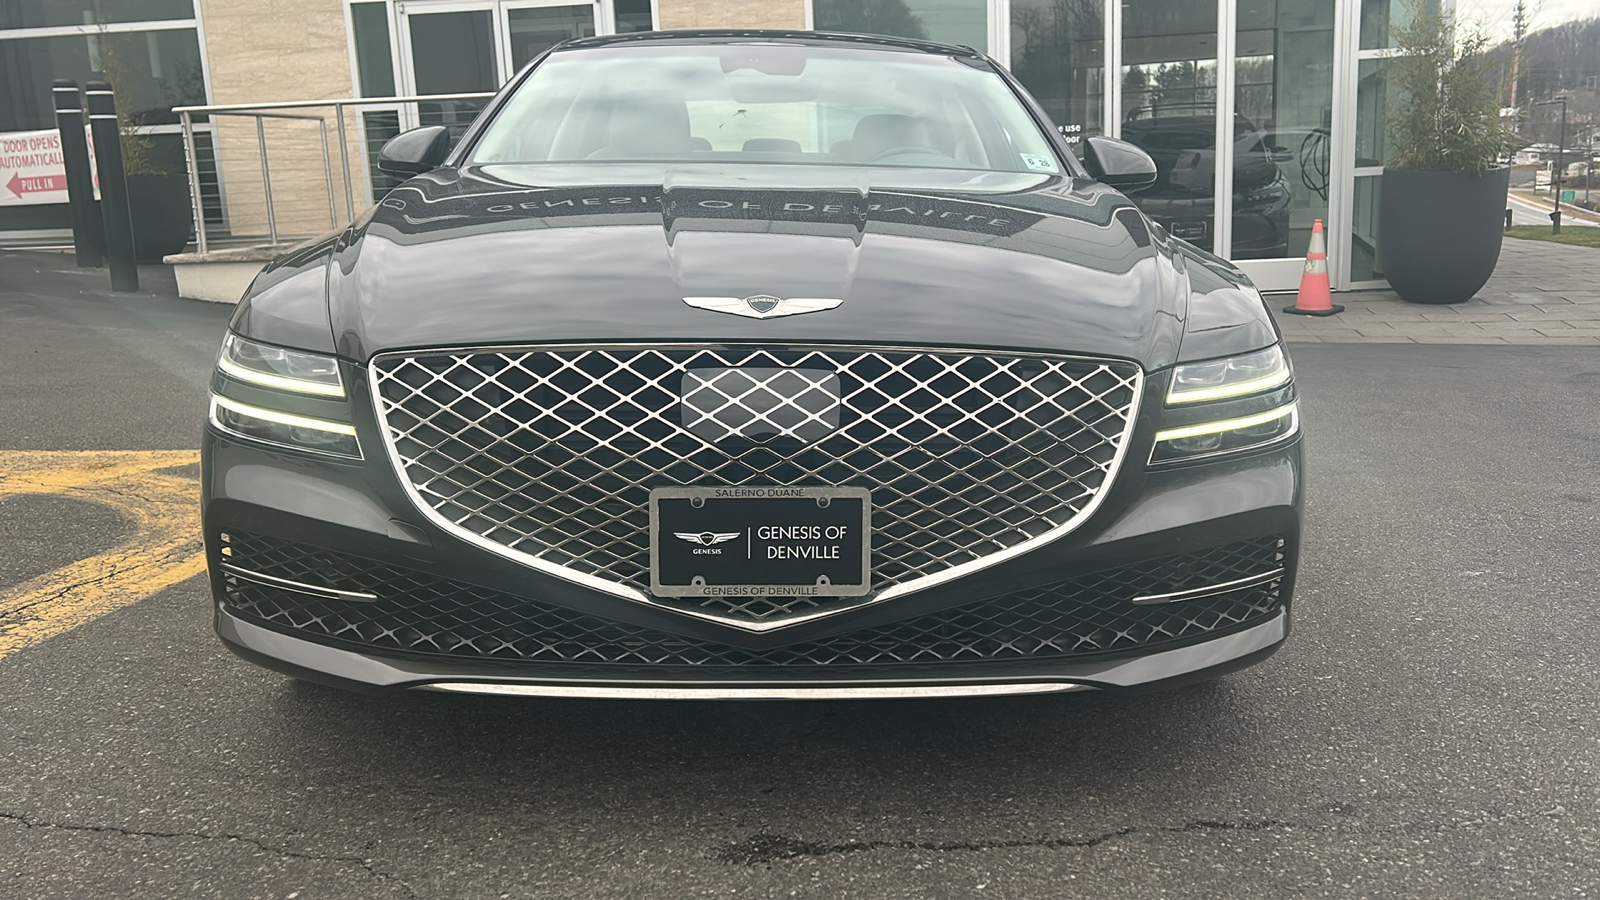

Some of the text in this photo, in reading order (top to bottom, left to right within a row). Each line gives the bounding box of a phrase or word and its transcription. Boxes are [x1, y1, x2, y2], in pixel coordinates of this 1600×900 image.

[1065, 124, 1081, 132] use
[3, 135, 60, 153] DOOR OPENS
[1063, 134, 1080, 144] oor
[21, 177, 54, 190] PULL IN
[715, 488, 805, 498] SALERNO DUANE
[757, 526, 847, 540] GENESIS OF
[767, 545, 840, 559] DENVILLE
[703, 587, 818, 596] GENESIS OF DENVILLE
